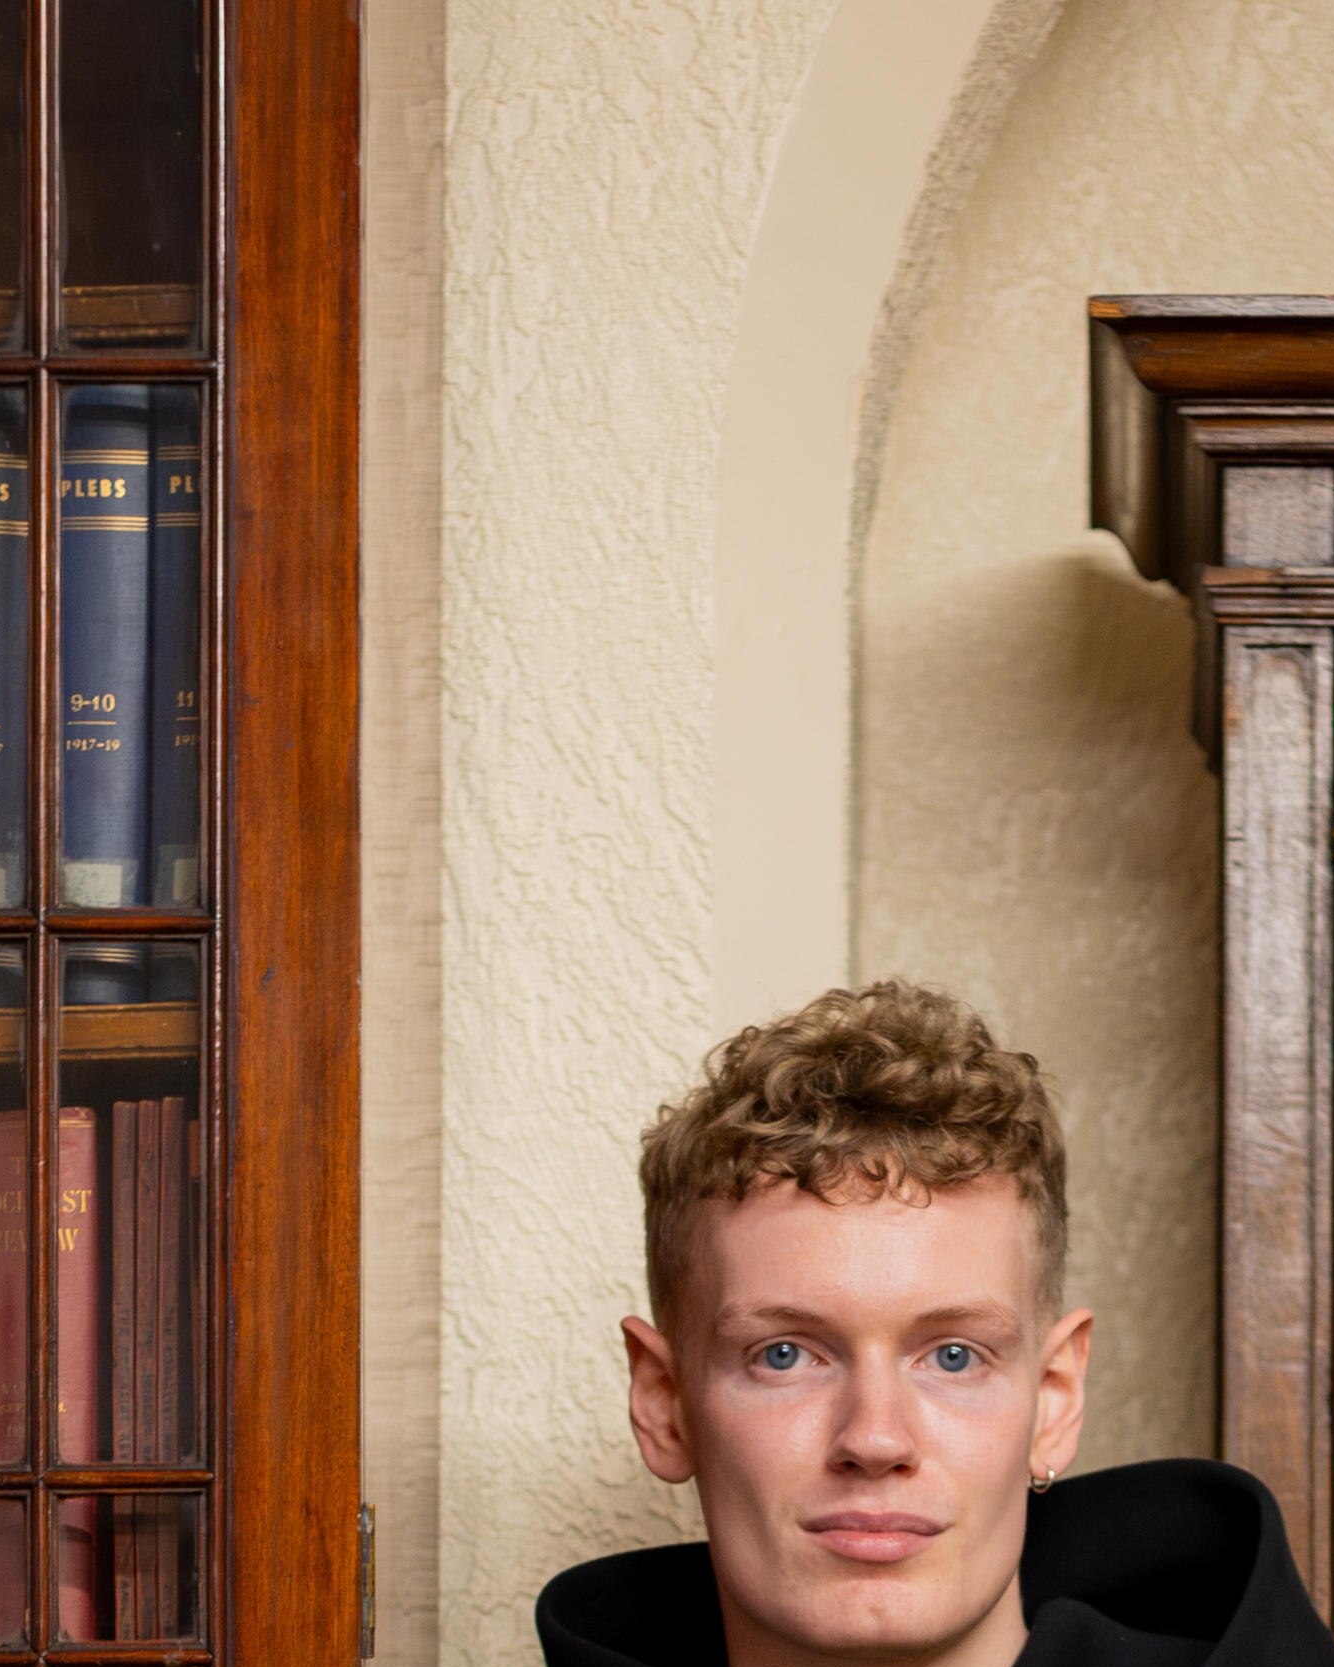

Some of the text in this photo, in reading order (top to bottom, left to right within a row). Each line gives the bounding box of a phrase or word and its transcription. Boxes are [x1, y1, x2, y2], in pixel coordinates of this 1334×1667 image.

[61, 478, 127, 499] PLEBS
[70, 693, 117, 713] 9-10
[65, 738, 121, 753] 1917-19
